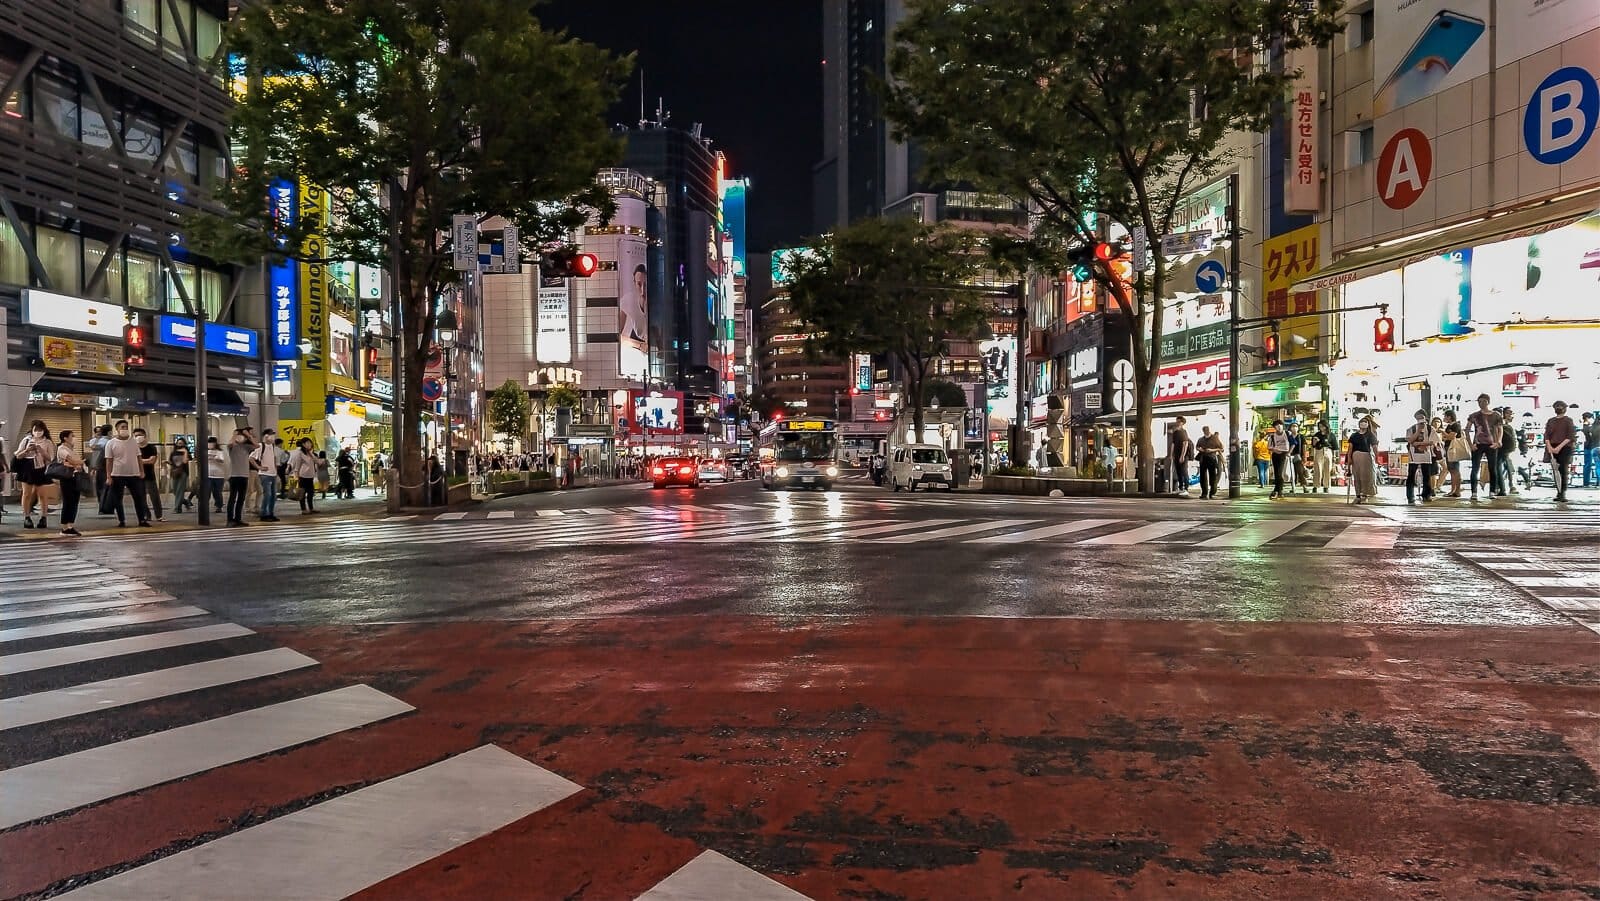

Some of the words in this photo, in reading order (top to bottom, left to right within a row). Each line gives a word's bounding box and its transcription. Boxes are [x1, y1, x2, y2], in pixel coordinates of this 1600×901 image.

[1298, 92, 1313, 185] 処方せん受付
[1539, 79, 1586, 155] B
[1385, 137, 1422, 199] A
[1267, 237, 1318, 282] クスリ
[1328, 271, 1358, 286] CAMERA
[283, 425, 316, 437] マツモト
